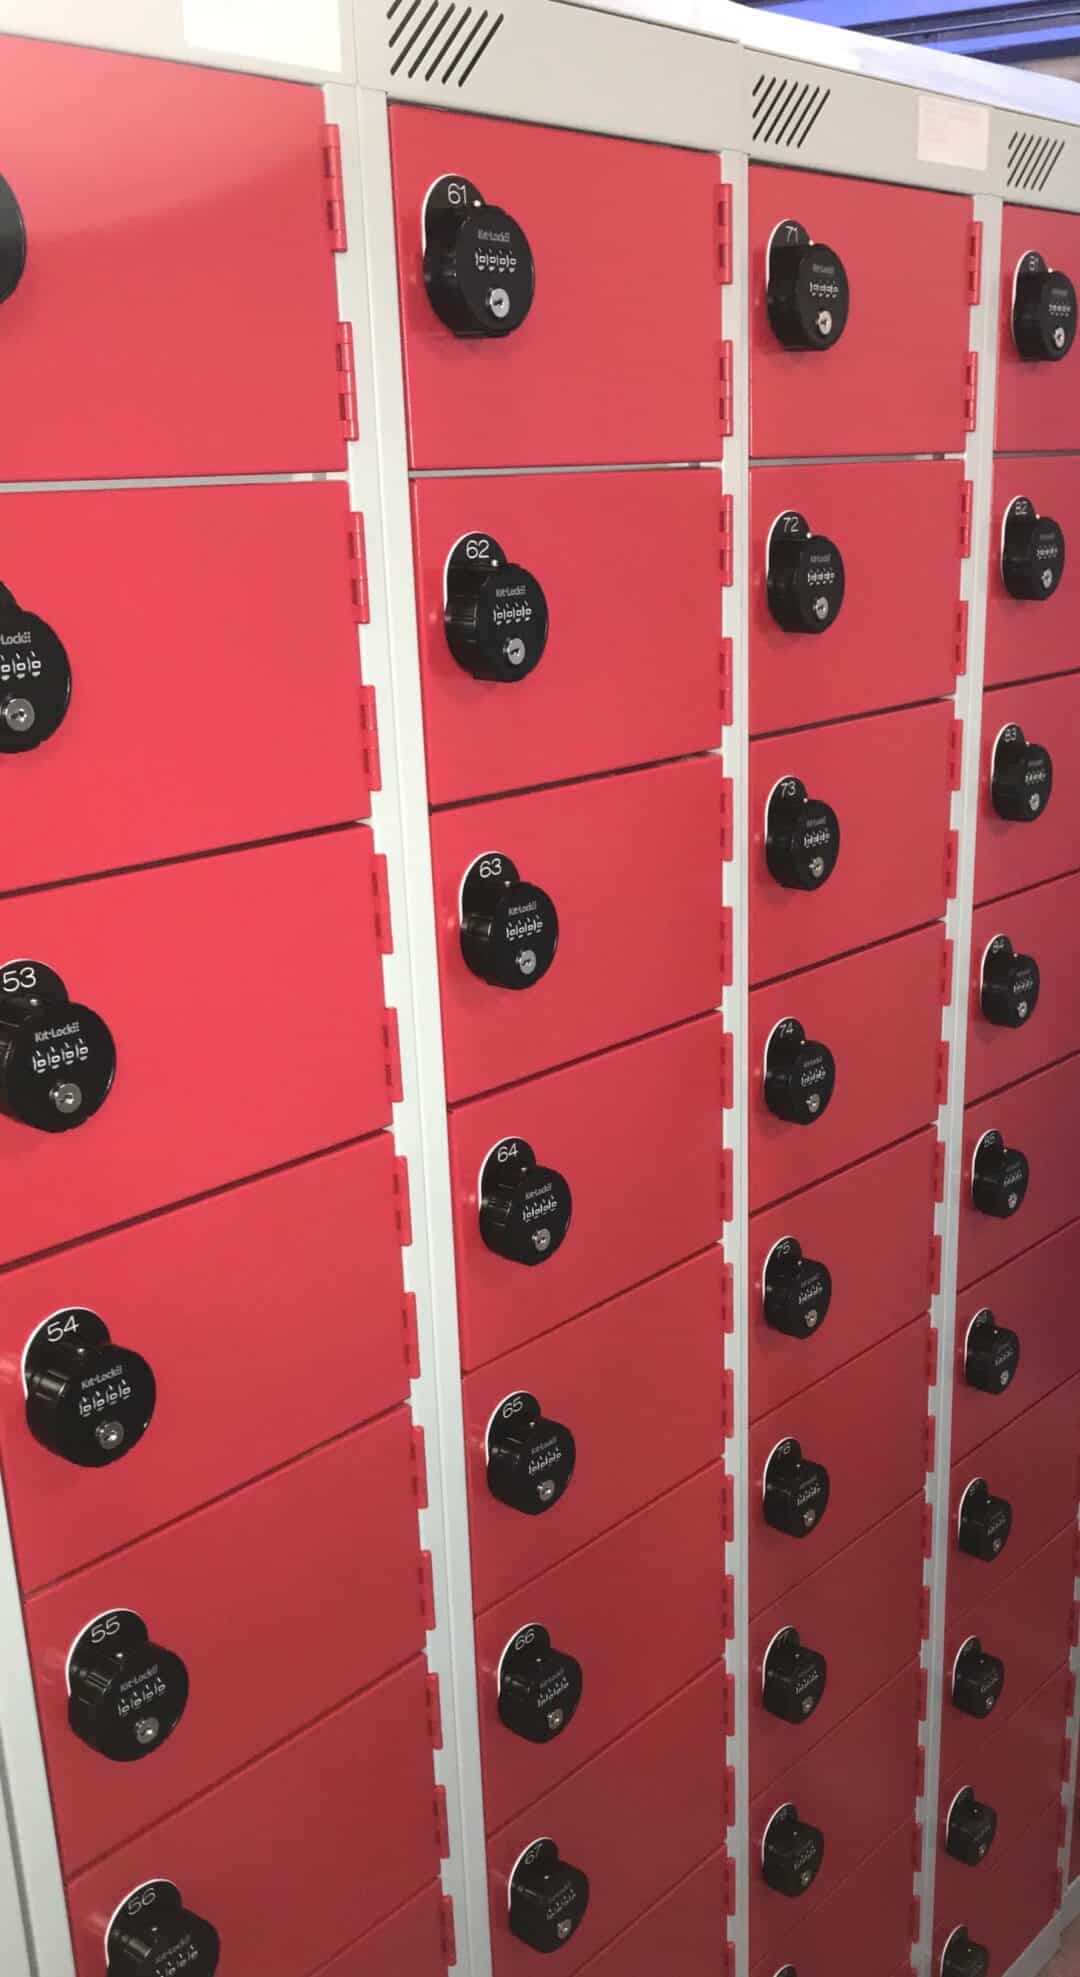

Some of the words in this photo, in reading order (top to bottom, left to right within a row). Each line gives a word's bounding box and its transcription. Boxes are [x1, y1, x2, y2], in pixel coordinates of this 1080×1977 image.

[447, 182, 468, 205] 61
[783, 224, 801, 245] 71
[783, 516, 800, 533] 72
[465, 539, 490, 559] 62
[781, 780, 796, 799] 73
[479, 857, 502, 878] 63
[2, 966, 37, 992] 53
[779, 1022, 795, 1039] 74
[496, 1143, 519, 1163] 64
[47, 1314, 80, 1342] 54
[502, 1396, 524, 1419] 65
[91, 1615, 121, 1644] 55
[515, 1628, 535, 1651] 66
[126, 1887, 158, 1916] 56
